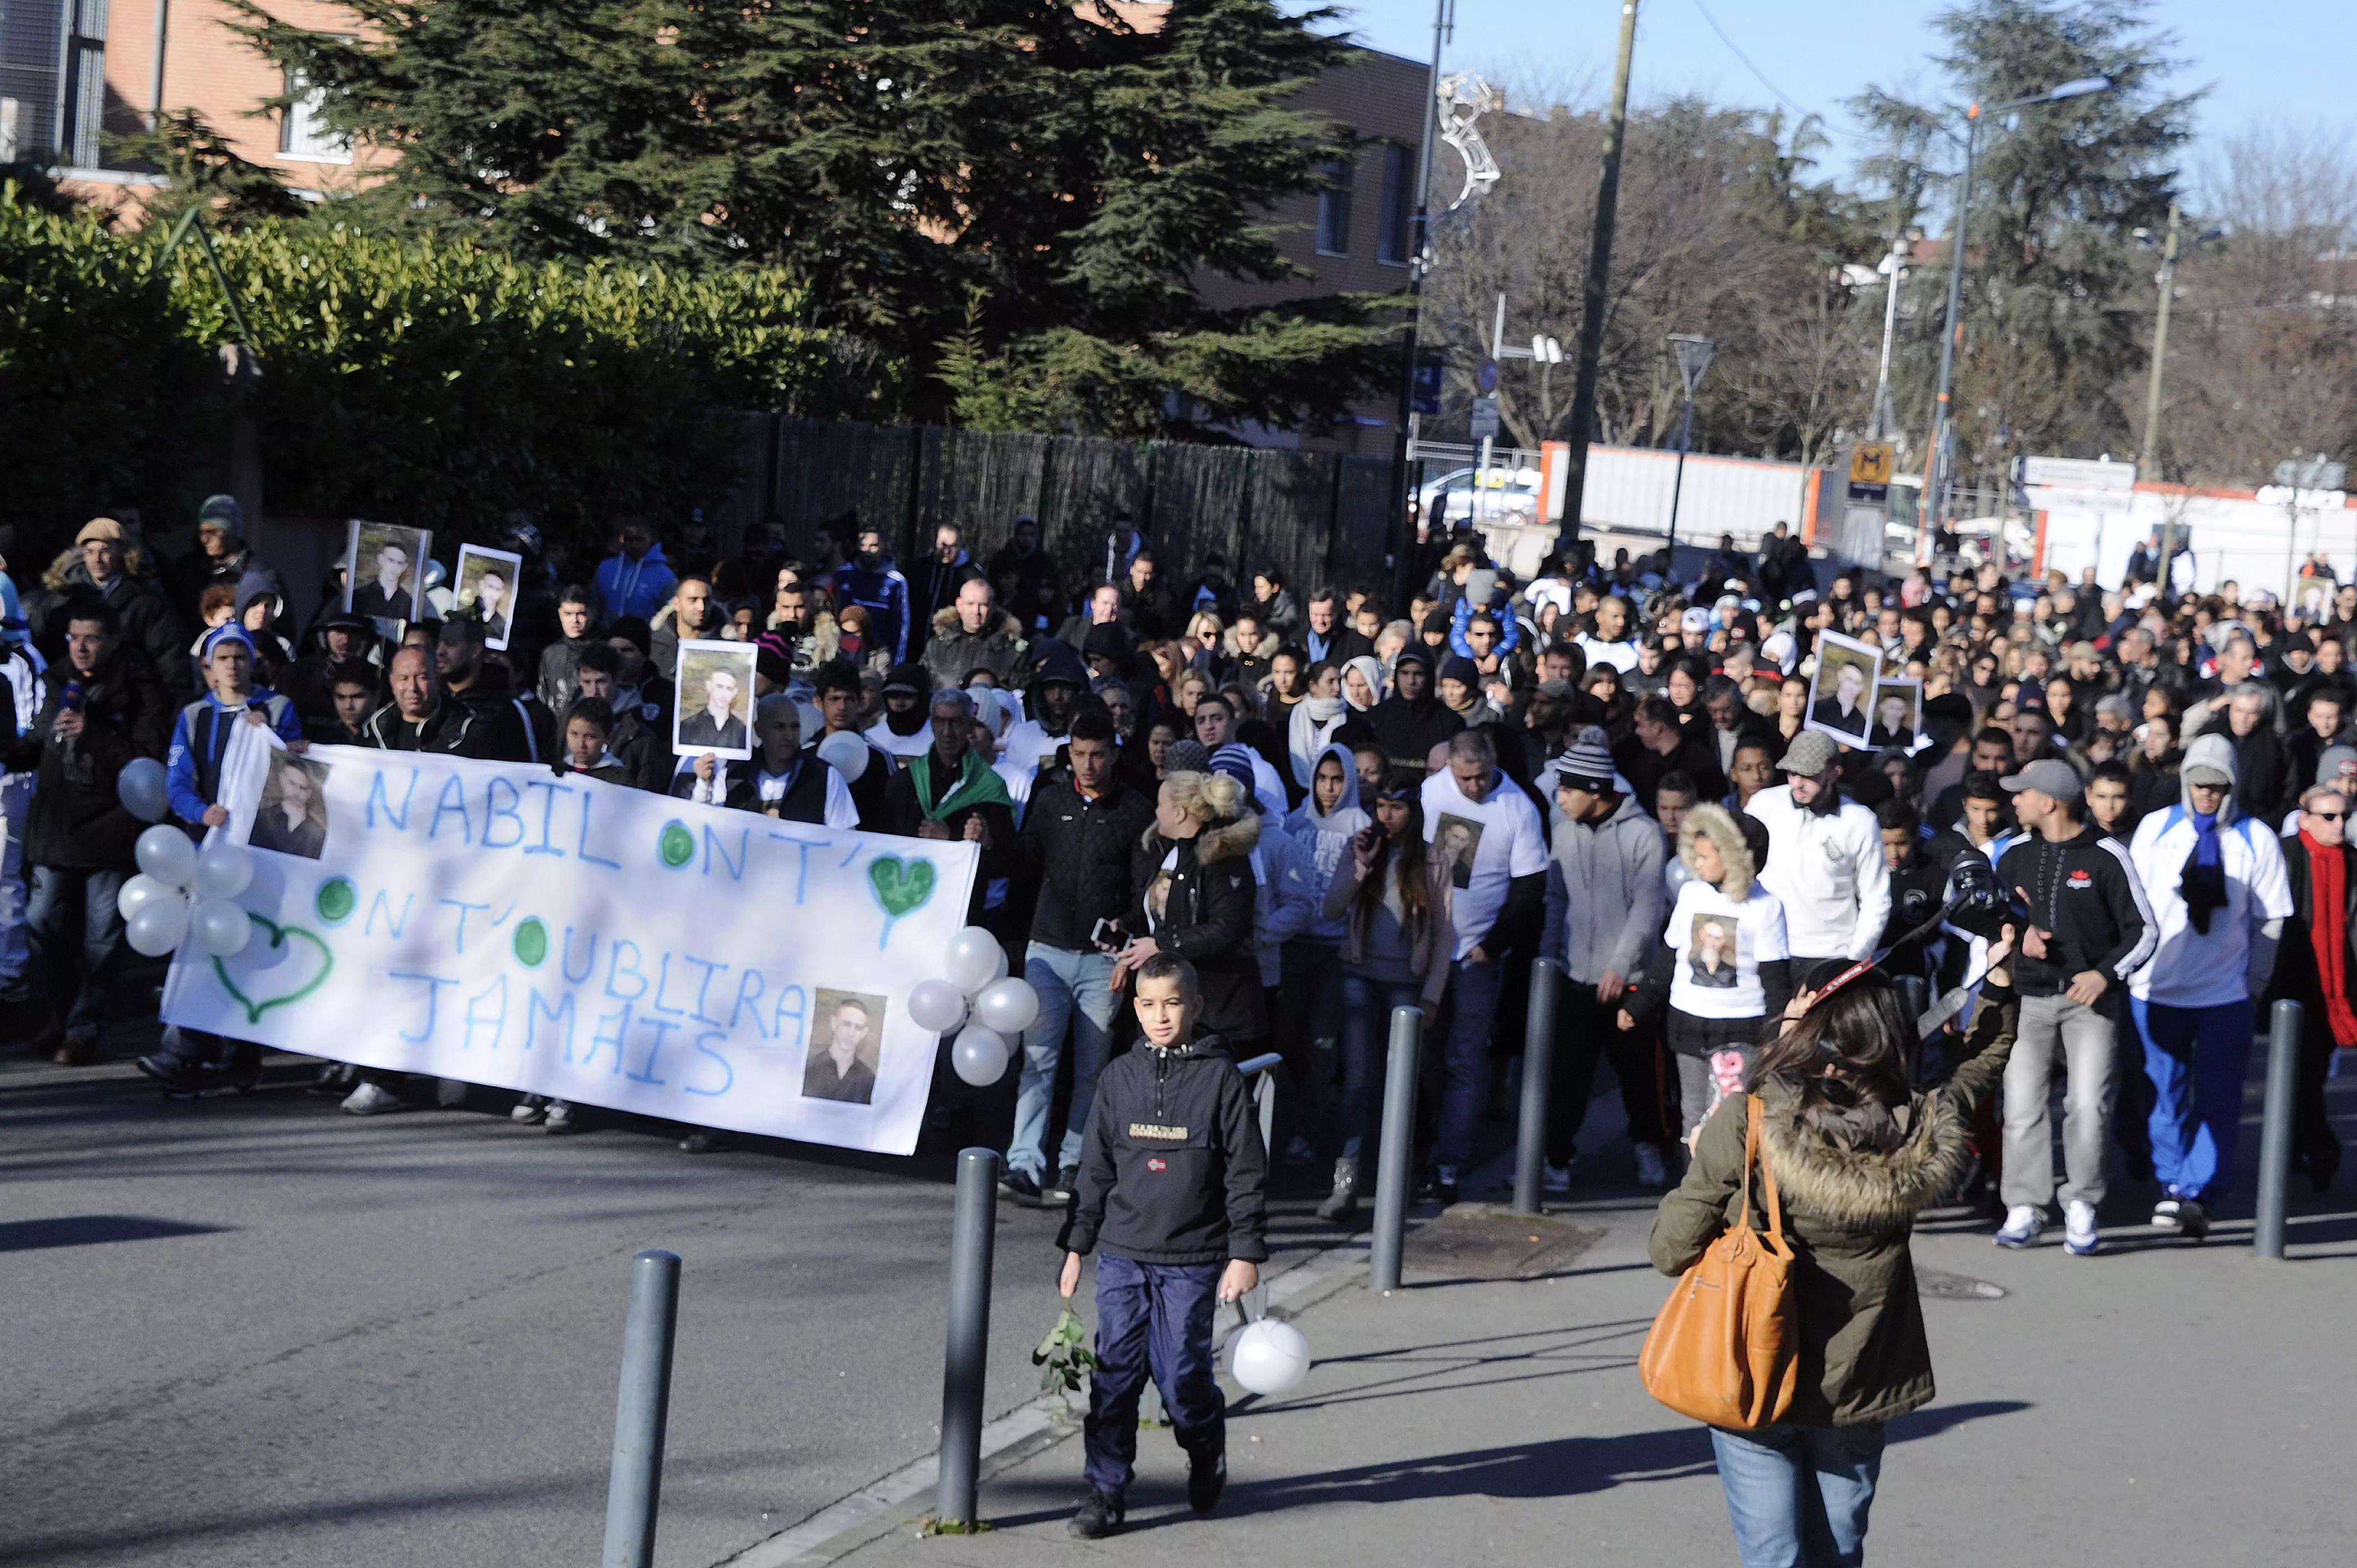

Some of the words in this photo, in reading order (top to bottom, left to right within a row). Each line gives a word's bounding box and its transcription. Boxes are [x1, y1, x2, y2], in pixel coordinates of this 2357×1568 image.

[366, 768, 621, 870] NABIL
[657, 818, 750, 881] ON
[315, 874, 415, 939] ON
[389, 970, 734, 1097] JAMAIS
